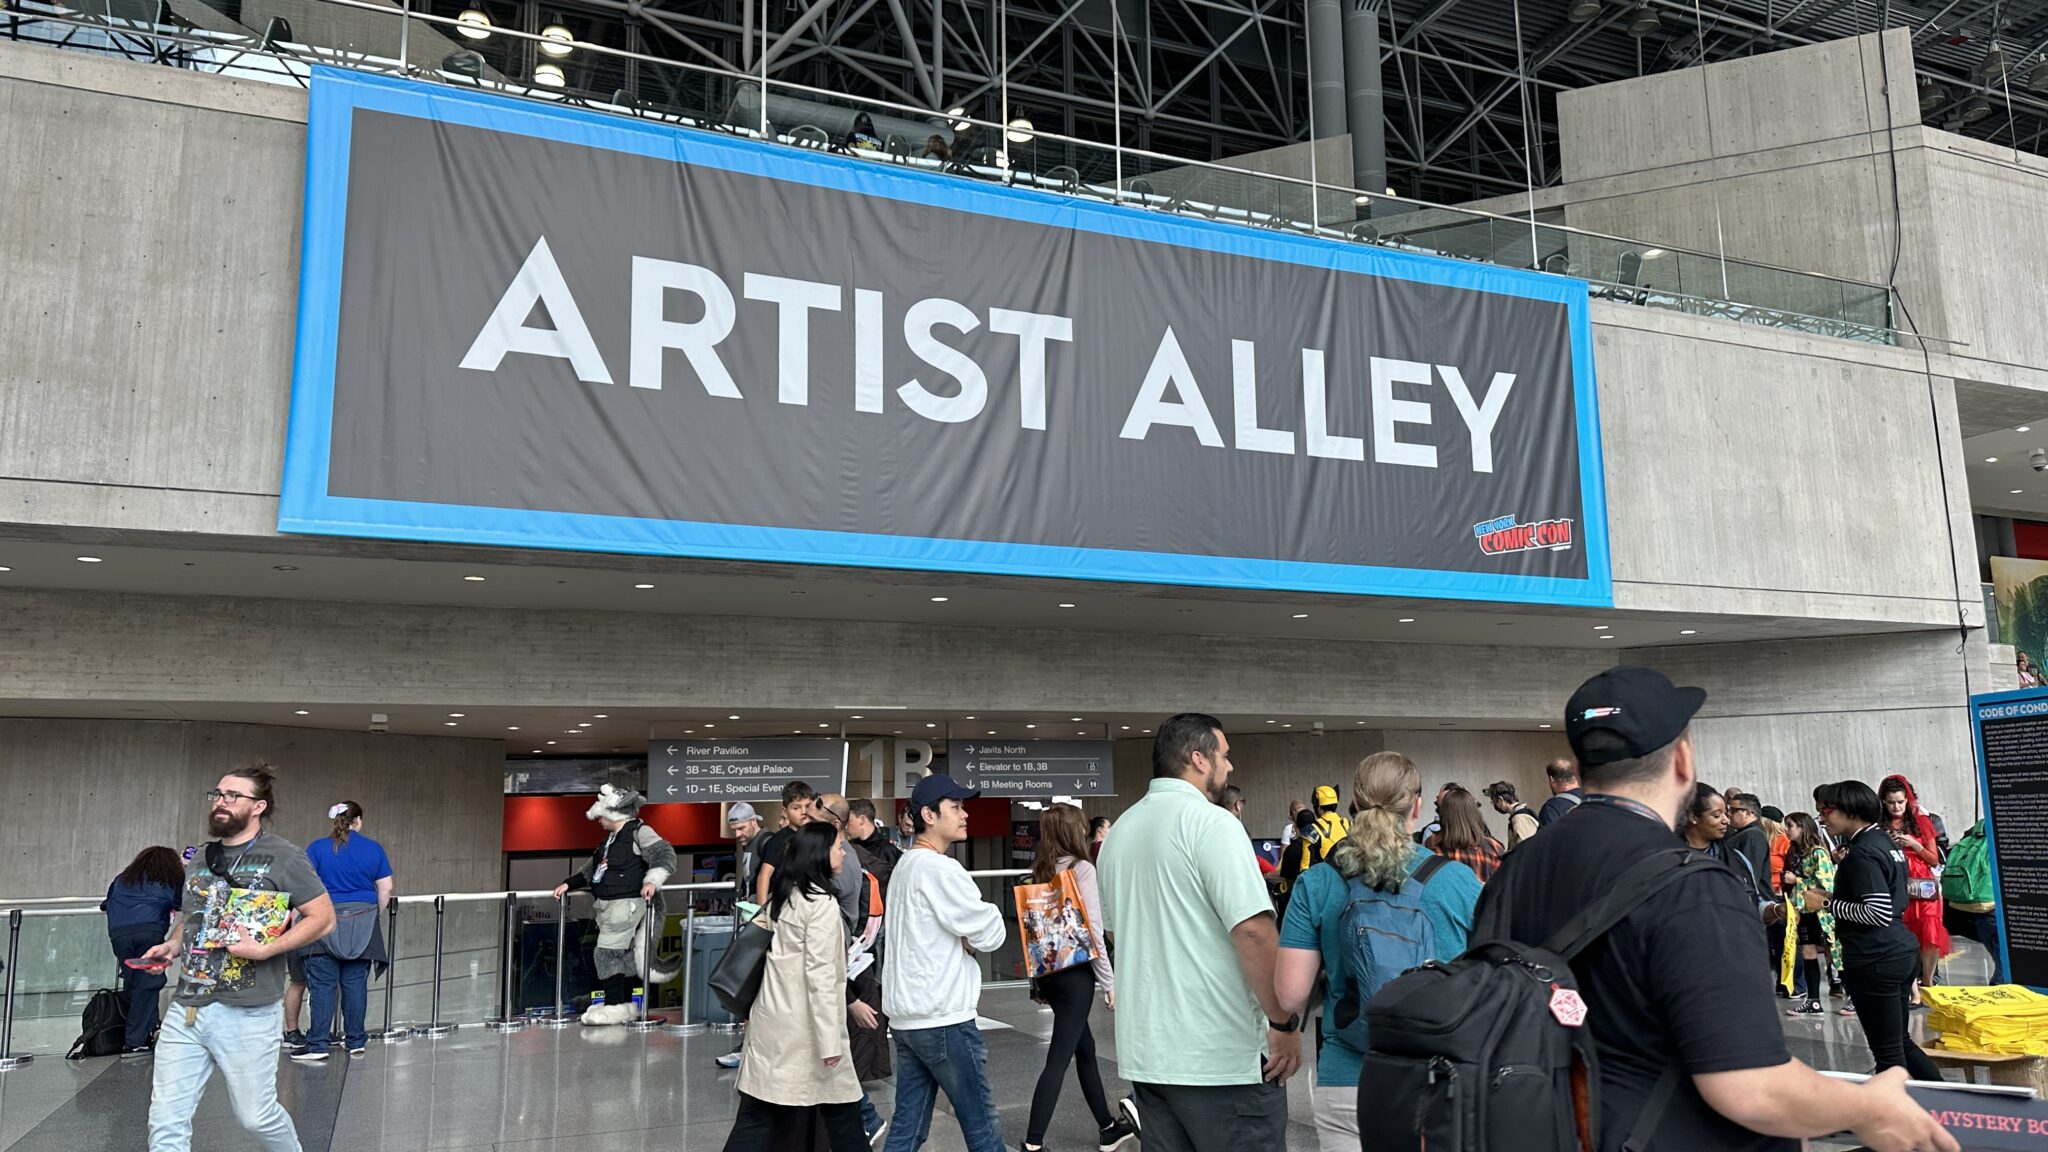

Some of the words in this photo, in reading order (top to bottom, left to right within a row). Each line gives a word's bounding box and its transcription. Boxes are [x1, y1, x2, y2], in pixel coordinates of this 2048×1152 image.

[458, 234, 1074, 431] ARTIST
[1118, 324, 1517, 473] ALLEY
[1475, 522, 1494, 536] NEW
[1494, 516, 1515, 532] YORK
[1481, 524, 1537, 552] COMIC
[1536, 521, 1570, 545] CON
[1979, 707, 2004, 718] CODE
[2006, 705, 2018, 716] OF
[2020, 702, 2048, 714] COND
[686, 746, 711, 755] River
[713, 746, 749, 755] Pavilion
[979, 745, 1002, 754] Javits
[1003, 746, 1026, 754] North
[686, 765, 699, 774] 3B
[710, 765, 725, 775] 3E,
[727, 764, 760, 775] Crystal
[762, 764, 793, 774] Palace
[860, 740, 933, 798] 1B
[979, 763, 1011, 771] Elevator
[1012, 763, 1021, 771] to
[686, 785, 699, 794] 1D
[708, 785, 723, 795] 1E,
[725, 784, 760, 795] Special
[980, 780, 990, 789] 1B
[992, 780, 1023, 790] Meeting
[1025, 780, 1053, 789] Rooms
[1930, 1109, 2023, 1132] MYSTERY
